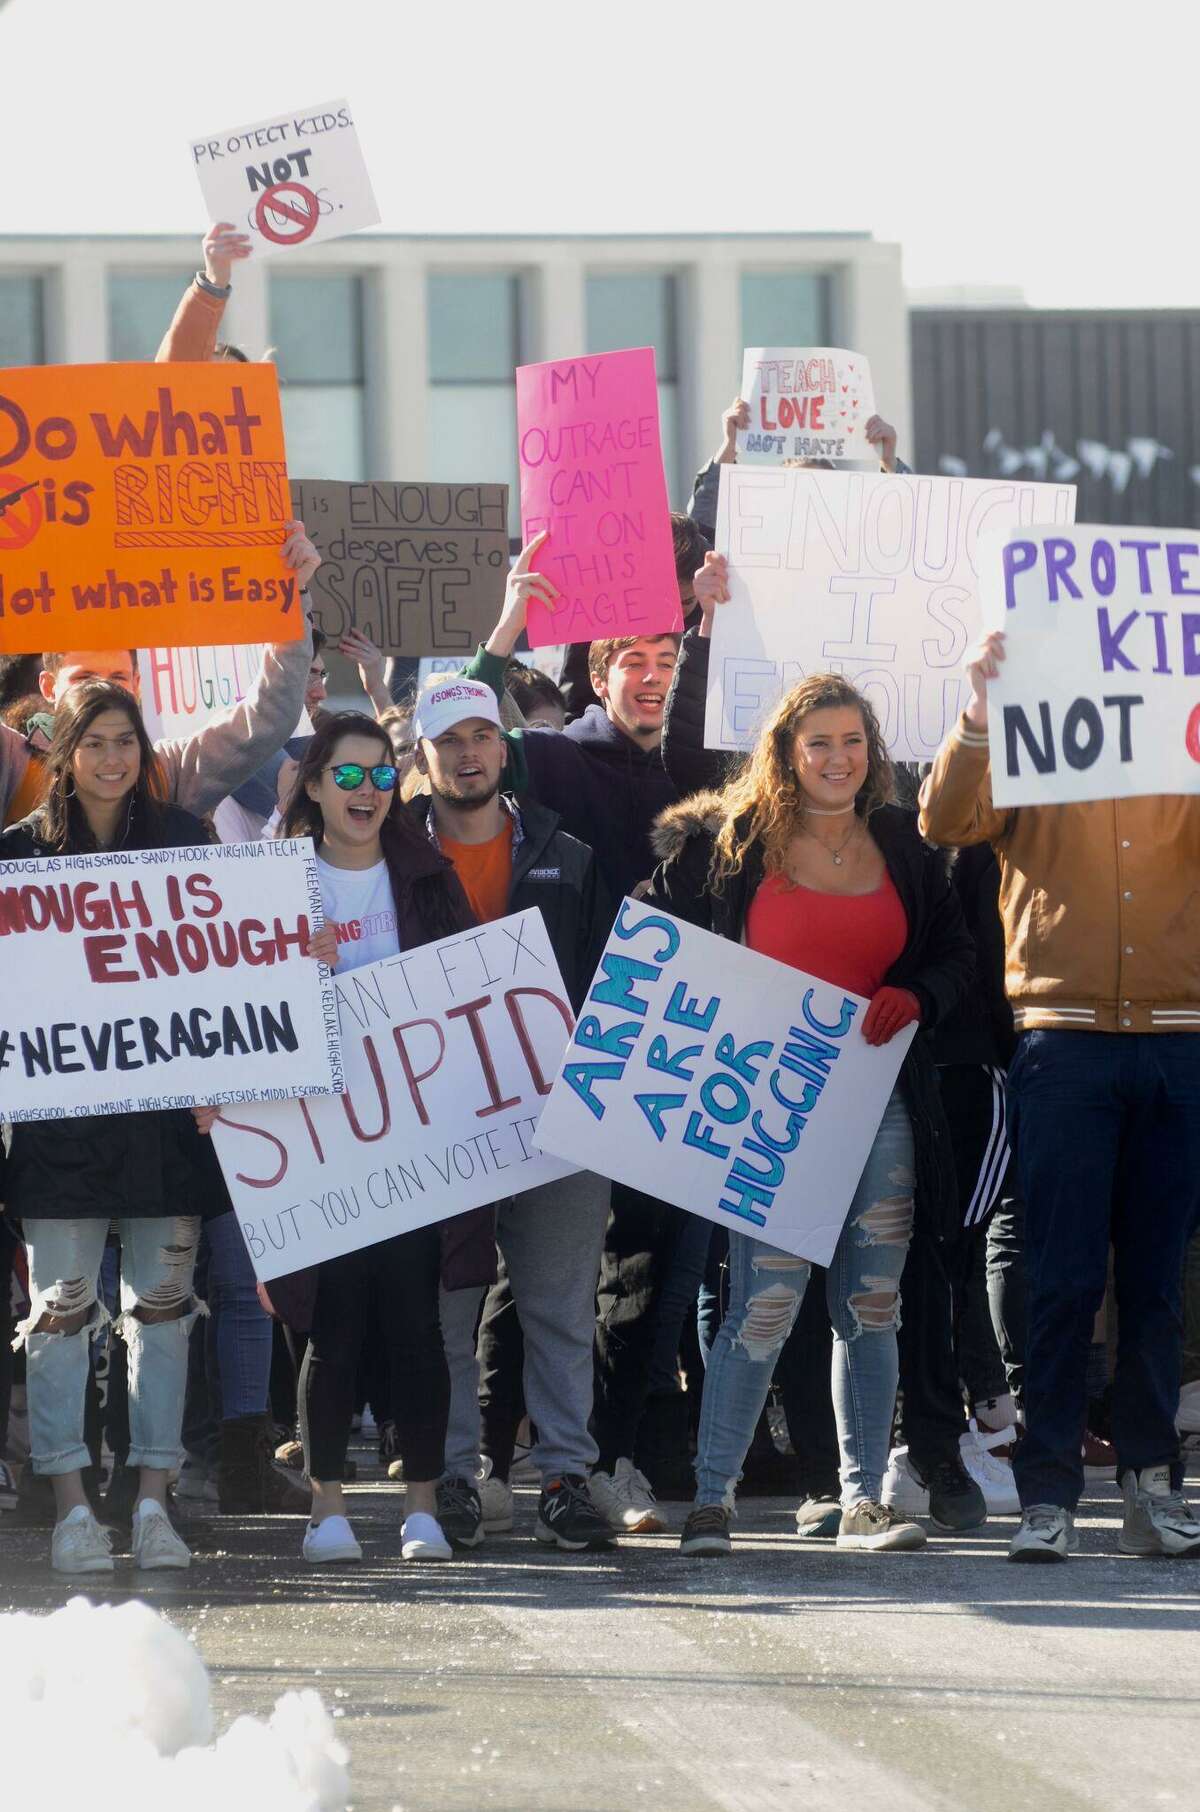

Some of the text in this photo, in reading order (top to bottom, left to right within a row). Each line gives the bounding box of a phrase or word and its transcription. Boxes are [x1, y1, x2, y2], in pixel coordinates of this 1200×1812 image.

[193, 108, 354, 165] PROTECT KIDS.
[245, 147, 313, 192] NOT
[551, 361, 603, 404] MY
[754, 358, 837, 394] TEACH
[89, 386, 262, 459] what
[760, 395, 826, 431] LOVE
[521, 416, 655, 468] OUTRAGE
[746, 433, 787, 455] NOT
[42, 478, 95, 526] is
[113, 461, 288, 525] RIGHT
[312, 496, 329, 513] is
[349, 485, 506, 530] ENOUGH
[550, 461, 639, 507] CAN'T
[328, 528, 459, 564] deserves
[472, 538, 504, 568] to
[599, 511, 646, 548] ON
[72, 568, 178, 612] what
[188, 572, 215, 603] is
[222, 567, 295, 614] Easy
[553, 553, 637, 586] THIS
[1002, 538, 1200, 609] PROTE
[312, 562, 472, 650] SAFE
[551, 587, 649, 636] PAGE
[1003, 695, 1145, 777] NOT
[0, 858, 62, 876] DOUGLAS
[178, 848, 210, 862] HOOK
[215, 842, 265, 859] VIRGINIA
[267, 840, 299, 857] TECH
[166, 873, 223, 922] IS
[84, 914, 312, 982] ENOUGH
[436, 918, 546, 998] FIX
[562, 900, 681, 1121] ARMS
[633, 981, 720, 1142] ARE
[682, 1033, 775, 1160] FOR
[718, 988, 858, 1228] HUGGING
[242, 1203, 302, 1260] BUT
[310, 1186, 361, 1234] YOU
[367, 1159, 426, 1209] CAN
[424, 1128, 511, 1185] VOTE
